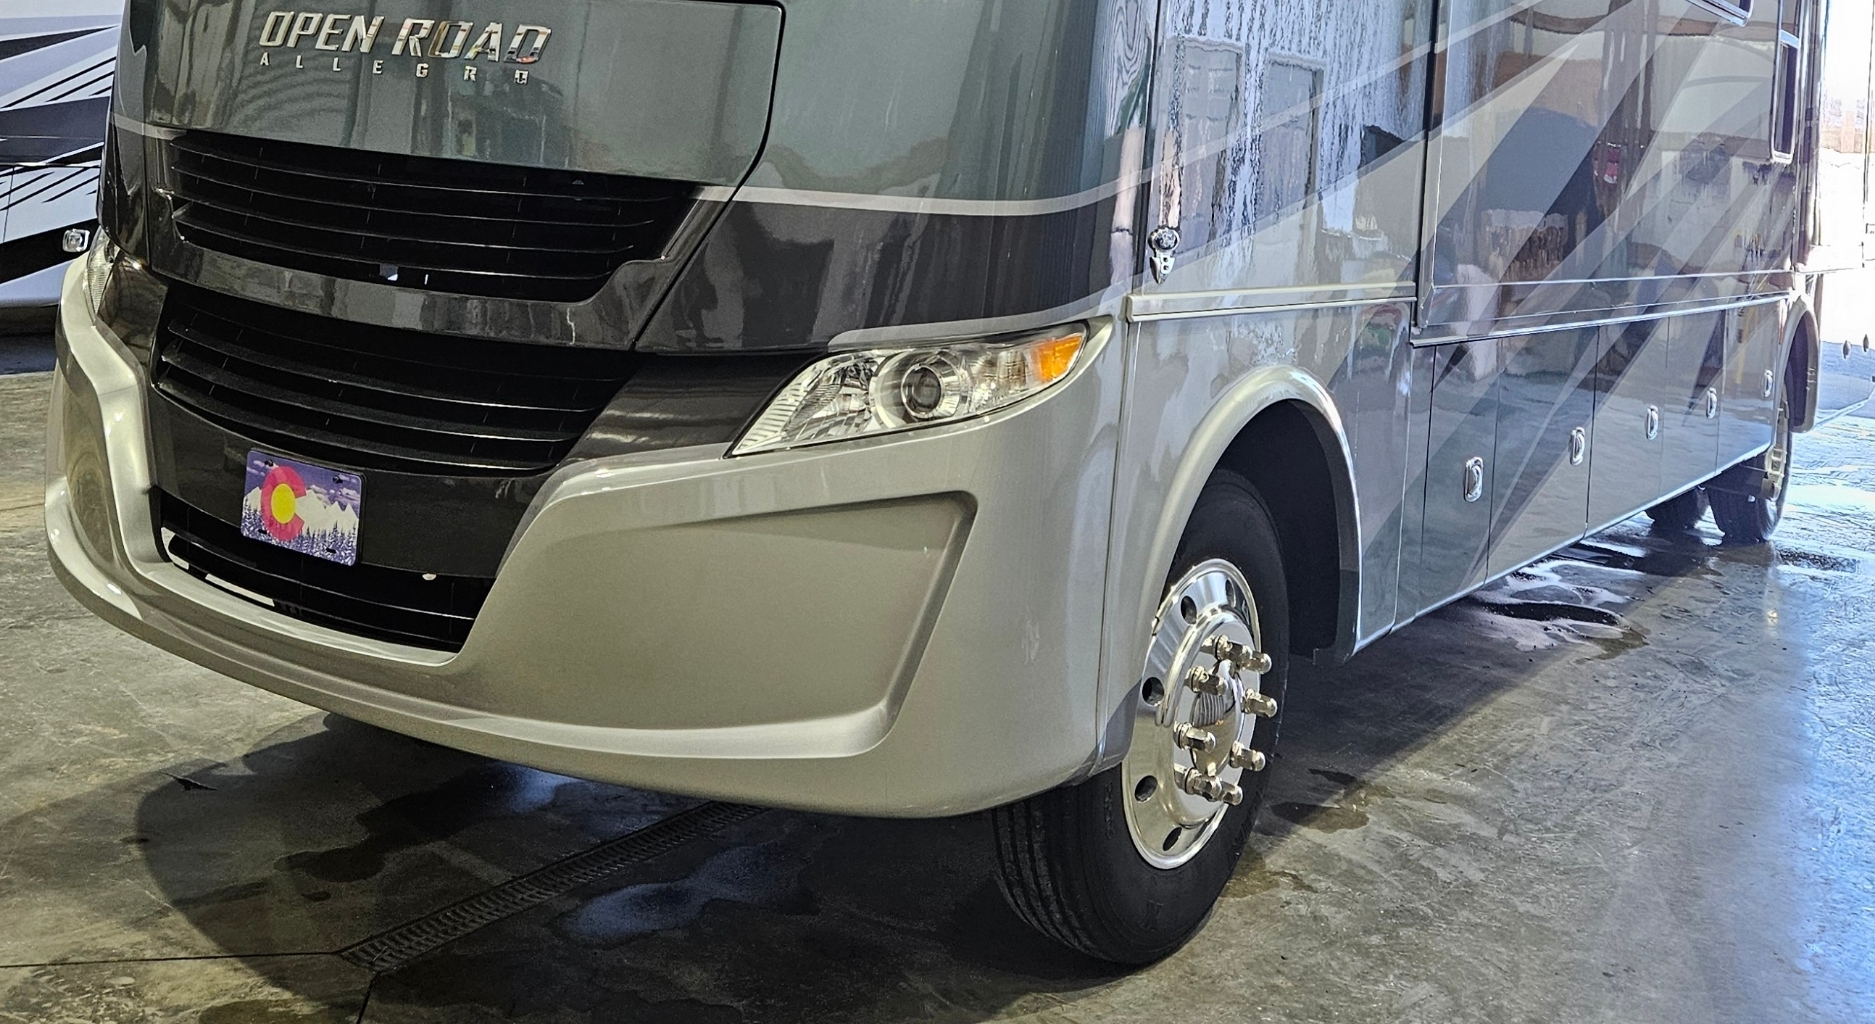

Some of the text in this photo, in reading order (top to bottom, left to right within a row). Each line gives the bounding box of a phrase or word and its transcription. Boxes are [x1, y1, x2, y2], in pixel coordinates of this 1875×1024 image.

[259, 11, 552, 64] OPEN ROAD
[259, 52, 529, 85] ALLEGRO
